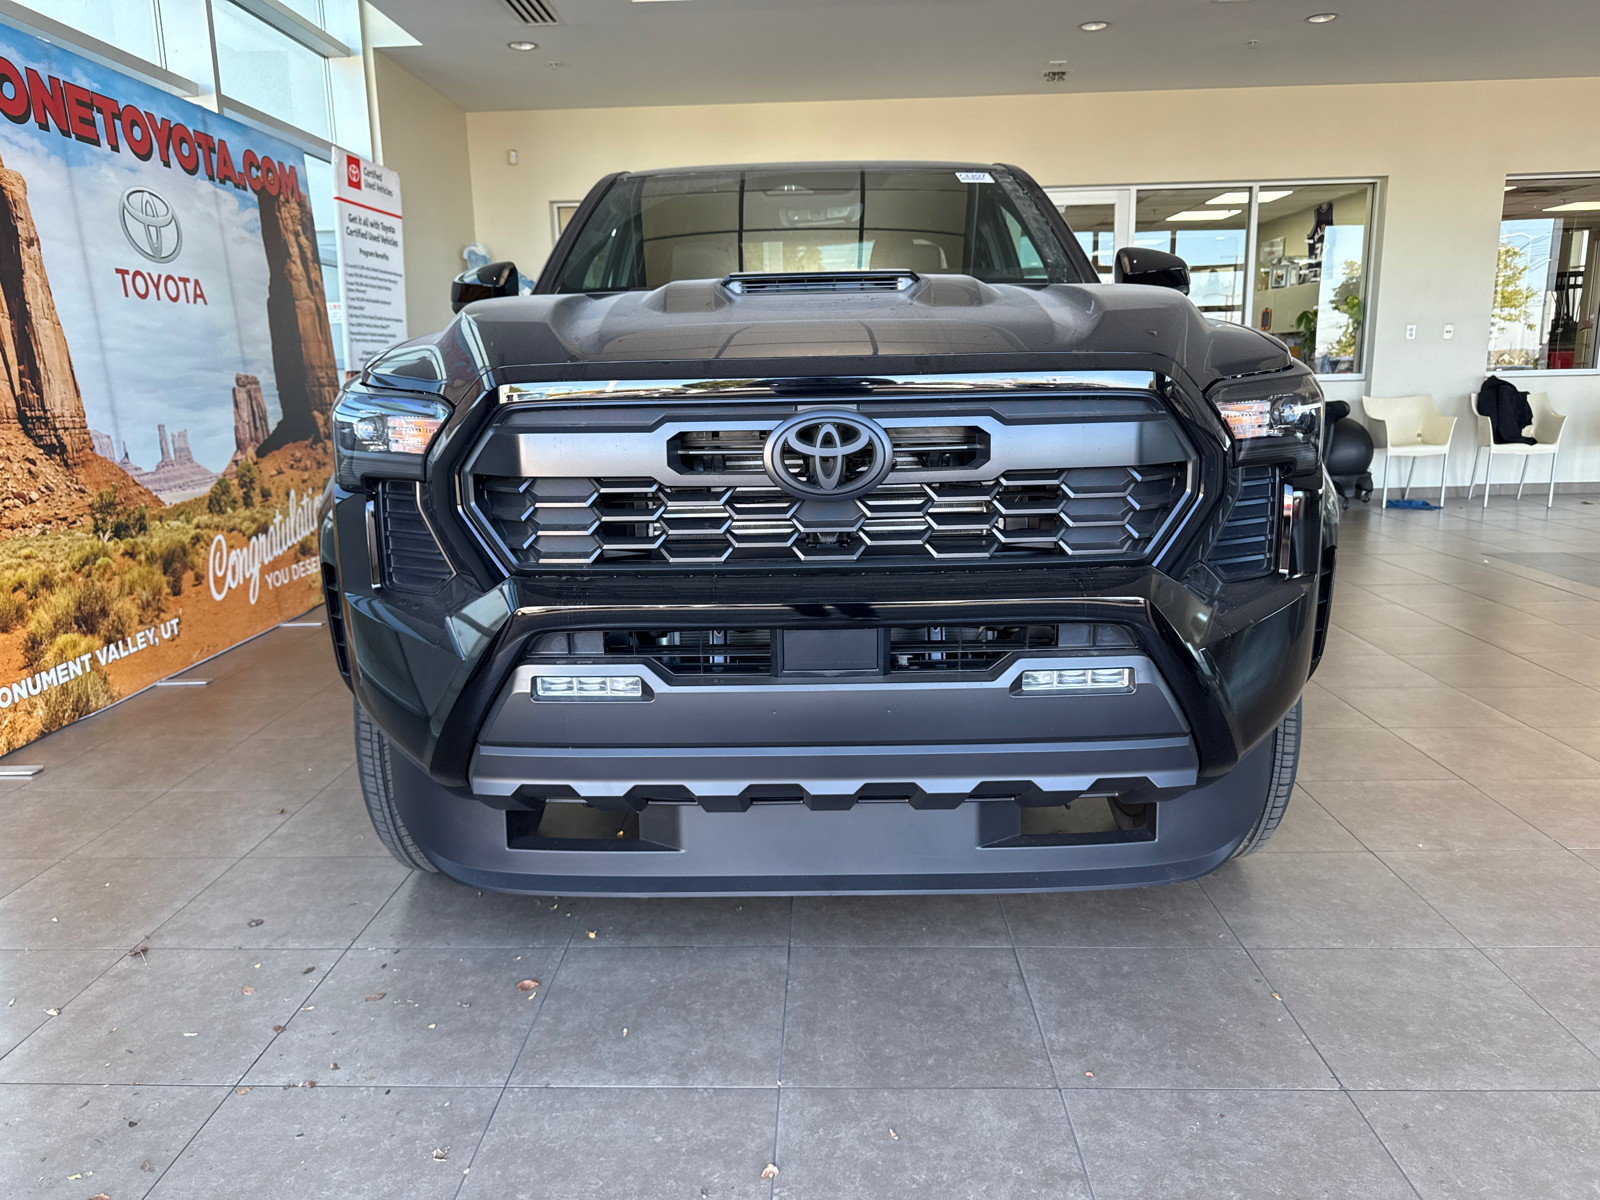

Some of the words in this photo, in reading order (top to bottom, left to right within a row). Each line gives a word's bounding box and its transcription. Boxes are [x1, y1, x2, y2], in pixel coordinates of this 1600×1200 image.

[0, 56, 300, 203] ONETOYOTA.COM
[363, 166, 382, 182] Certified
[364, 178, 376, 191] Used
[377, 183, 393, 197] Vehicles
[348, 213, 358, 224] Get
[358, 215, 362, 226] it
[370, 219, 380, 230] with
[380, 221, 395, 234] Toyota
[346, 226, 367, 240] Certified
[368, 232, 380, 243] Used
[381, 235, 398, 248] Vehicles
[359, 247, 375, 259] Program
[375, 250, 389, 261] Benefits
[114, 267, 208, 306] TOYOTA
[265, 567, 290, 590] YOU
[0, 652, 92, 709] ONUMENT
[95, 626, 160, 667] VALLEY,
[160, 617, 180, 640] UT
